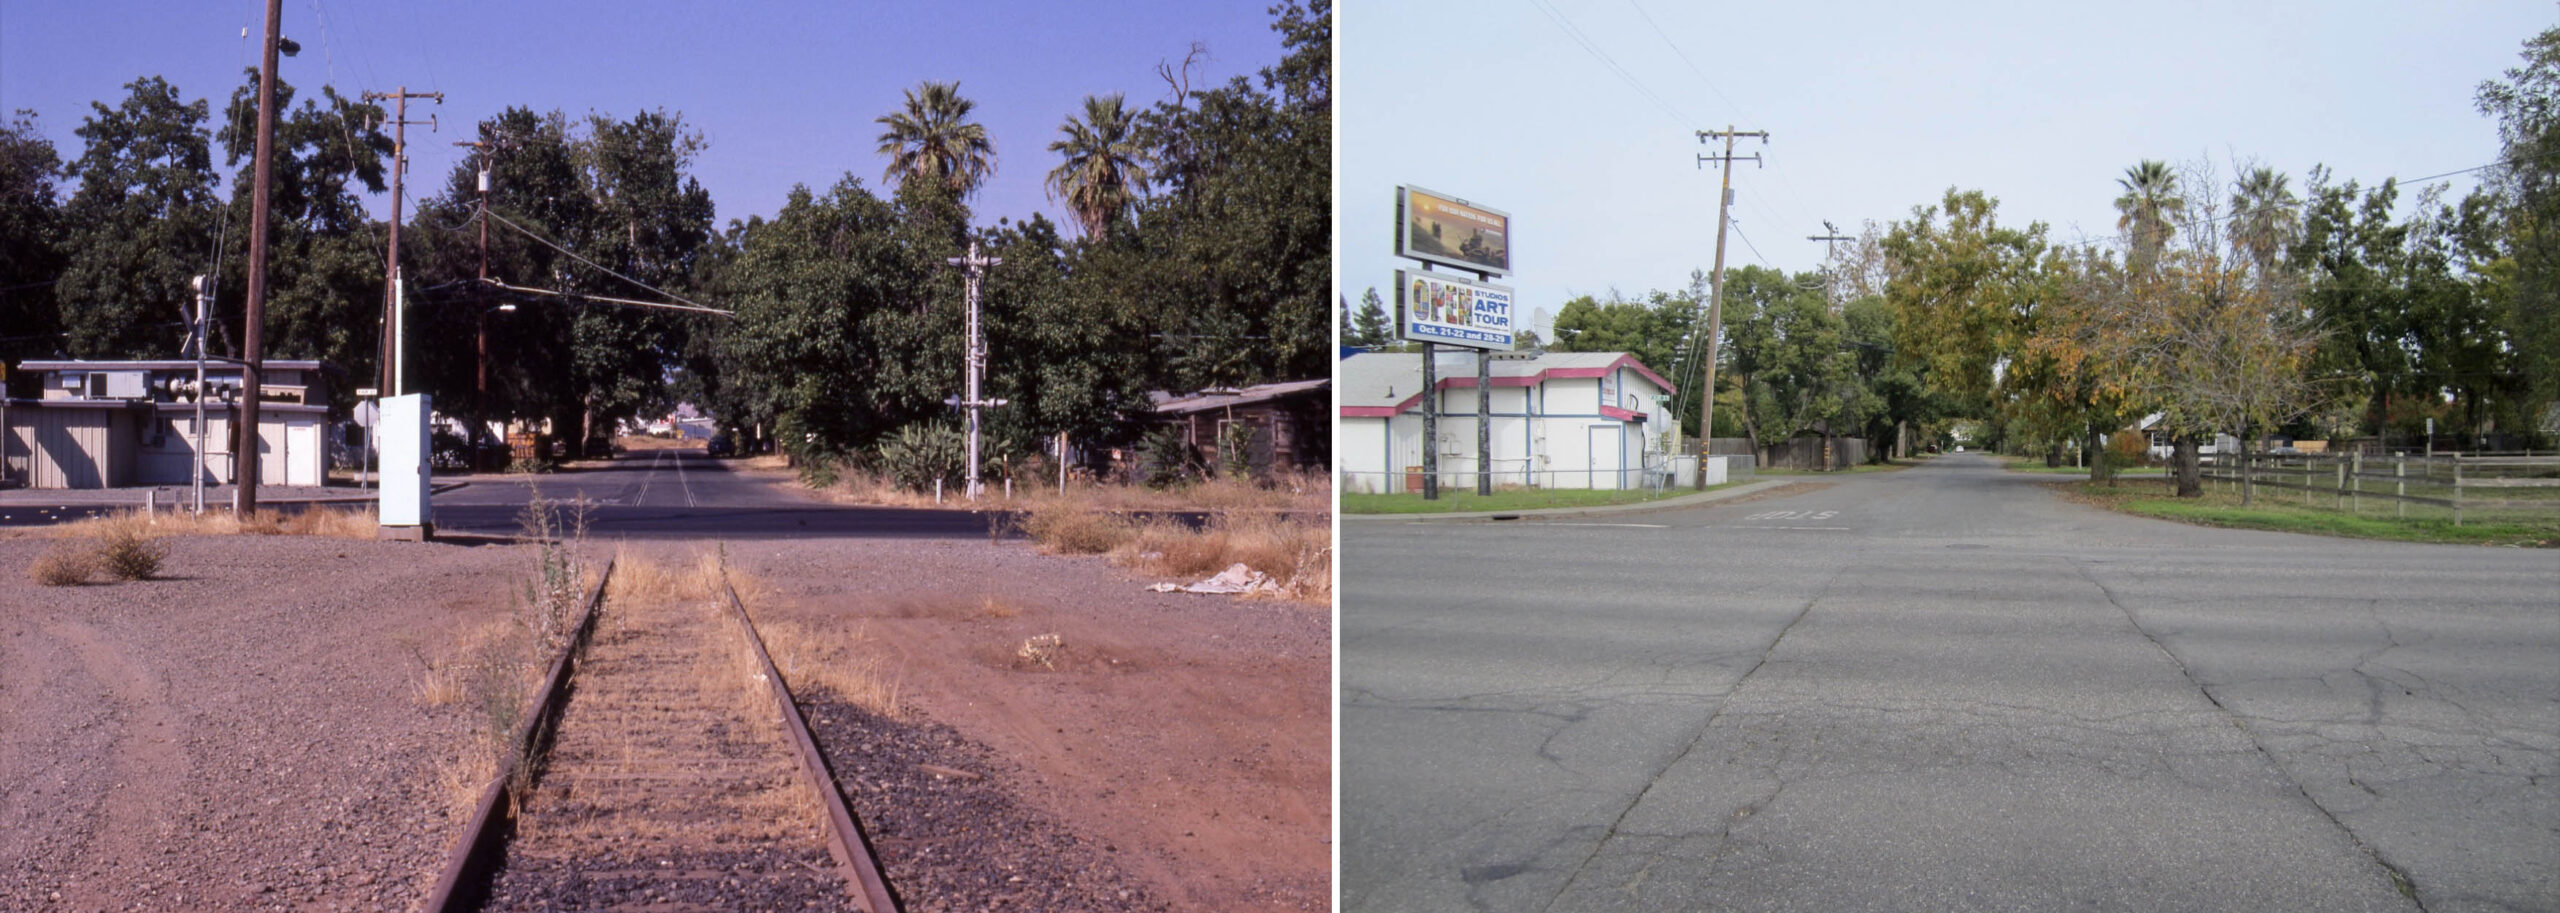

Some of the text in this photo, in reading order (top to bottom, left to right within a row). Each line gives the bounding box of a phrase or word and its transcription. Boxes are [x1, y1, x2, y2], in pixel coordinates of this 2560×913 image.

[1413, 279, 1473, 326] OPEN
[1475, 290, 1508, 301] STUDIOS
[1475, 299, 1508, 314] ART
[1474, 312, 1508, 326] TOUR
[1419, 325, 1438, 334] Oct.
[1440, 328, 1464, 338] 21-22
[1483, 333, 1505, 343] 28-29
